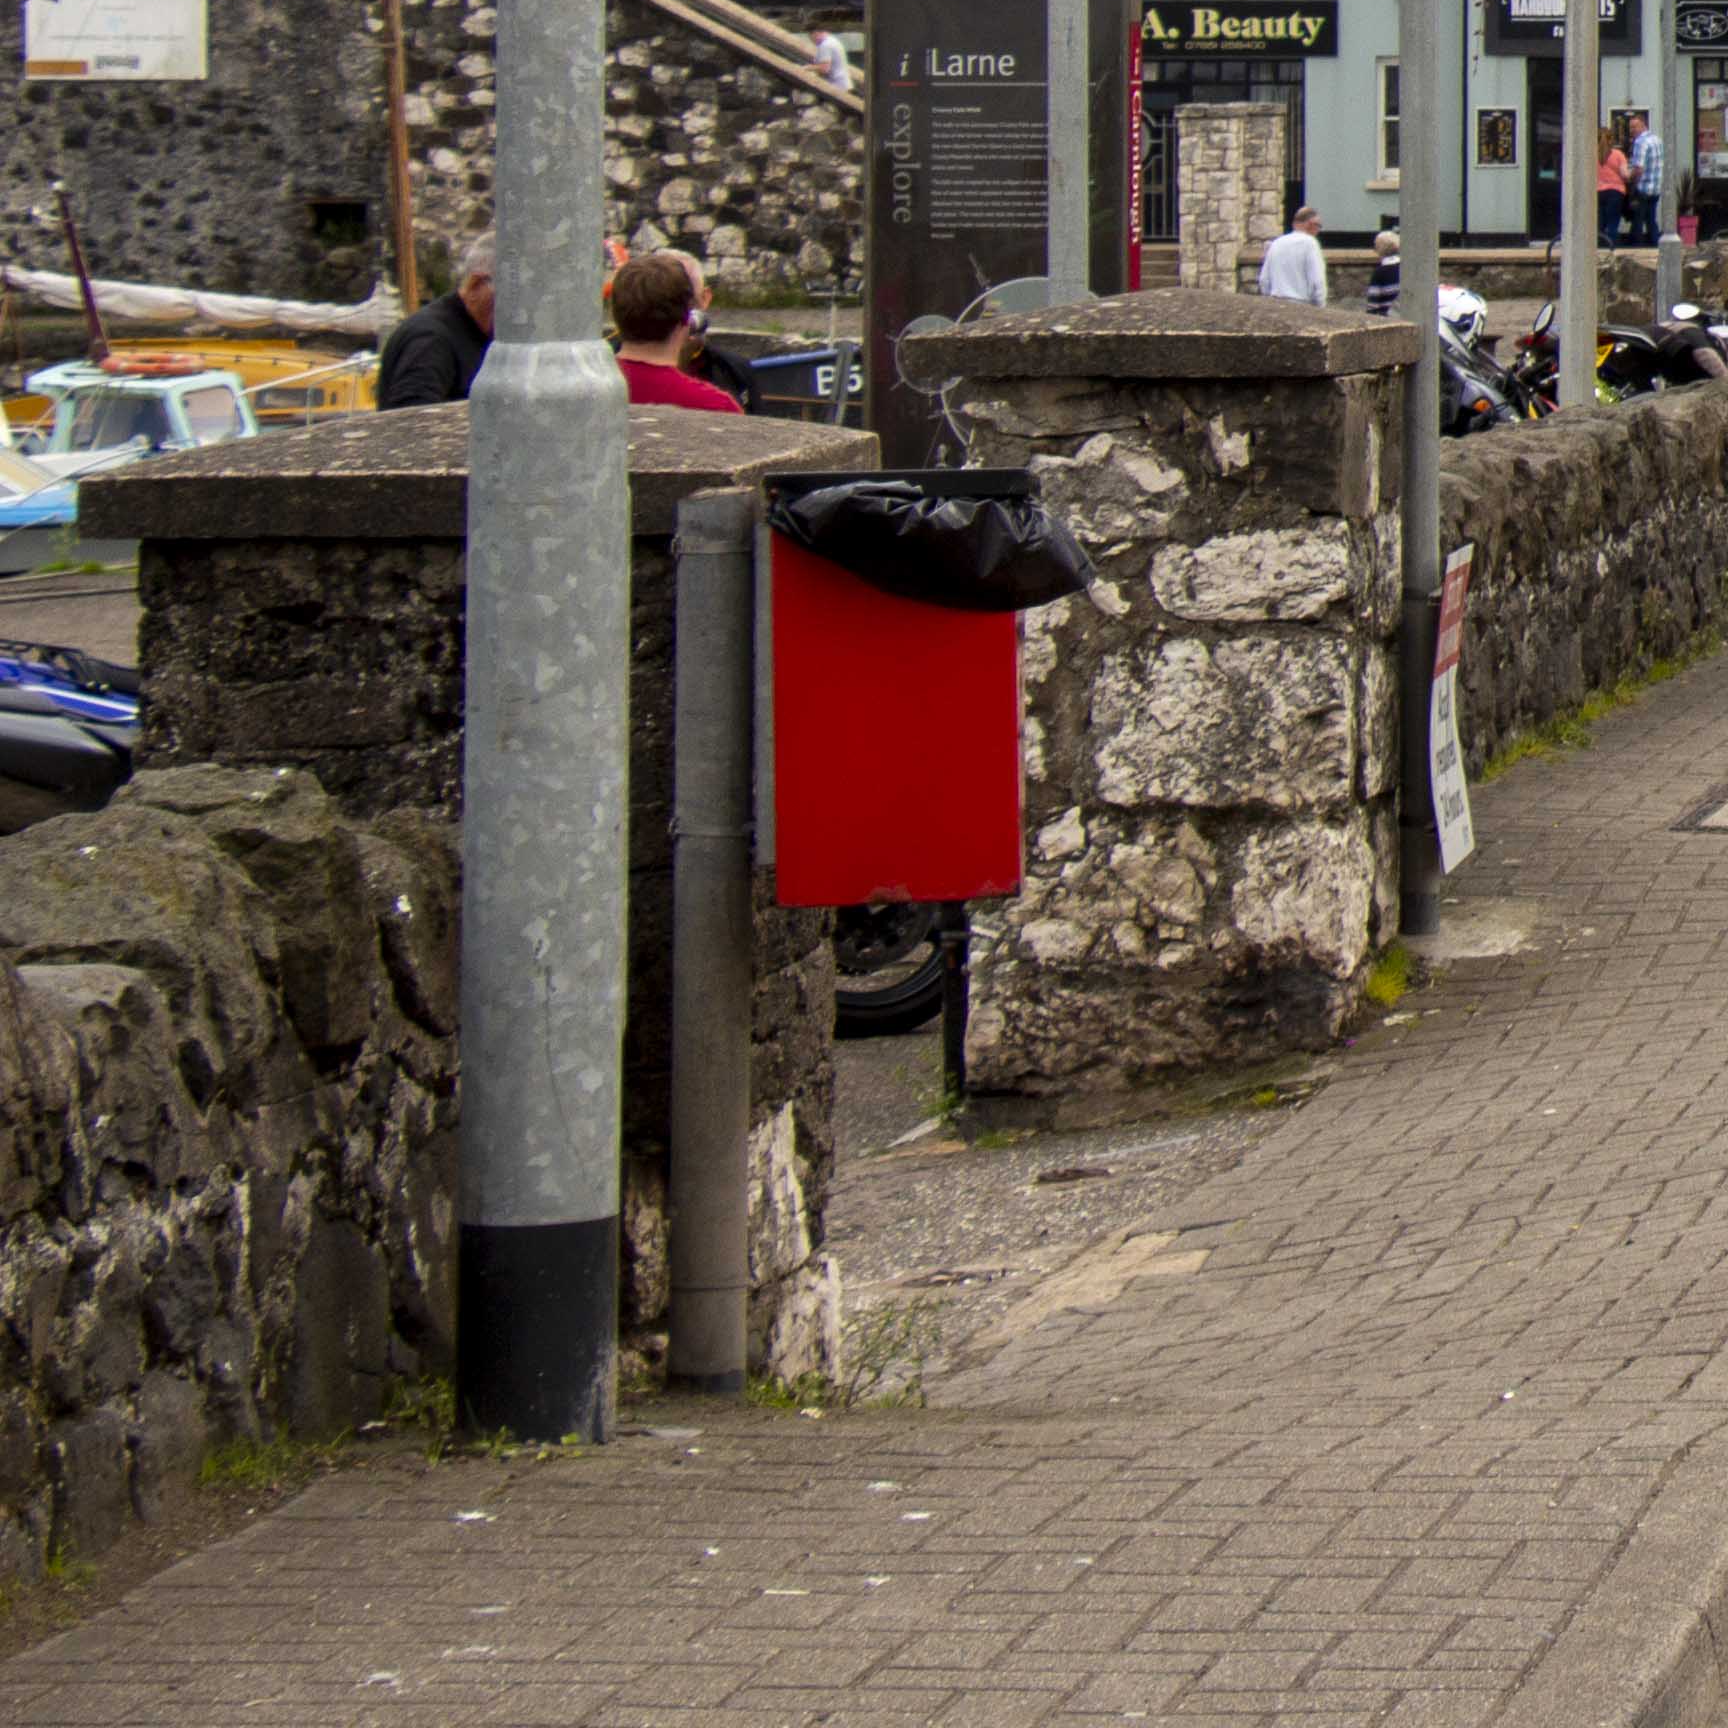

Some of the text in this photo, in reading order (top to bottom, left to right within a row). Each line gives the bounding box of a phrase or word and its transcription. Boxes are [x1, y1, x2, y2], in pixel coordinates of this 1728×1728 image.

[1192, 8, 1325, 46] Beauty
[931, 47, 1016, 76] Larne
[884, 102, 922, 223] explore
